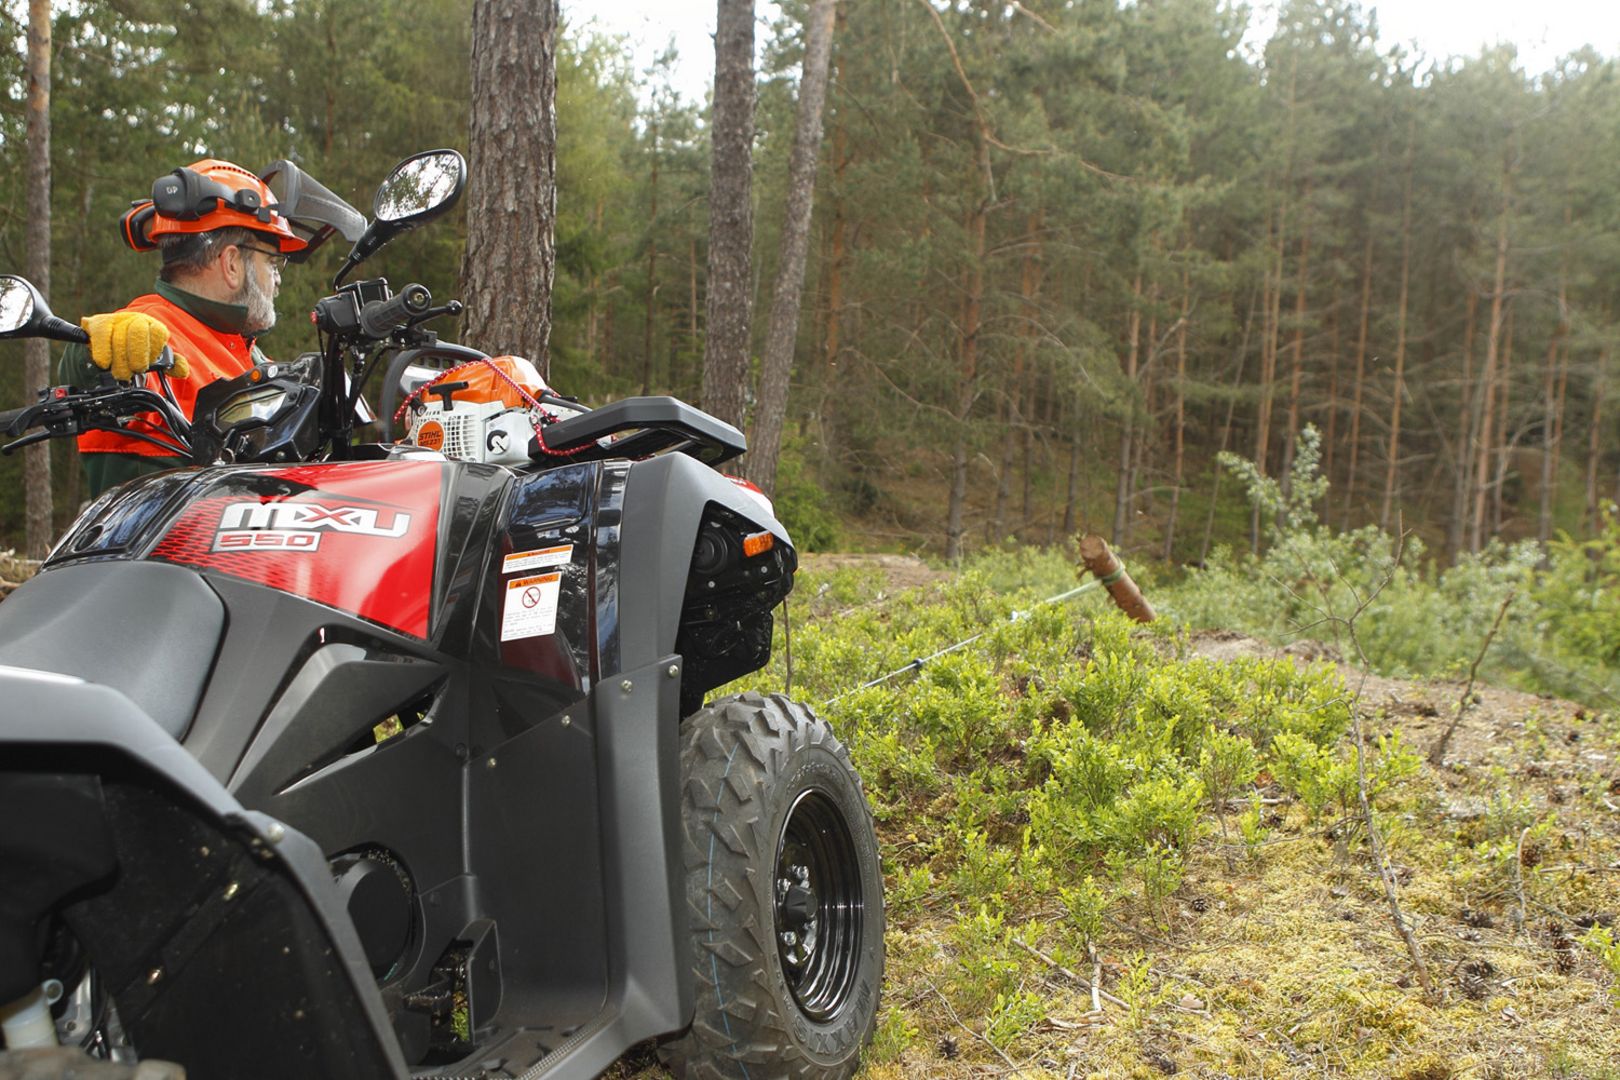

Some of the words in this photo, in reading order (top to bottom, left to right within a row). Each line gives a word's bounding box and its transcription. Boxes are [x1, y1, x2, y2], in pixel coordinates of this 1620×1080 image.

[419, 431, 441, 441] STIHL
[218, 502, 411, 538] MXU
[218, 533, 315, 548] 550
